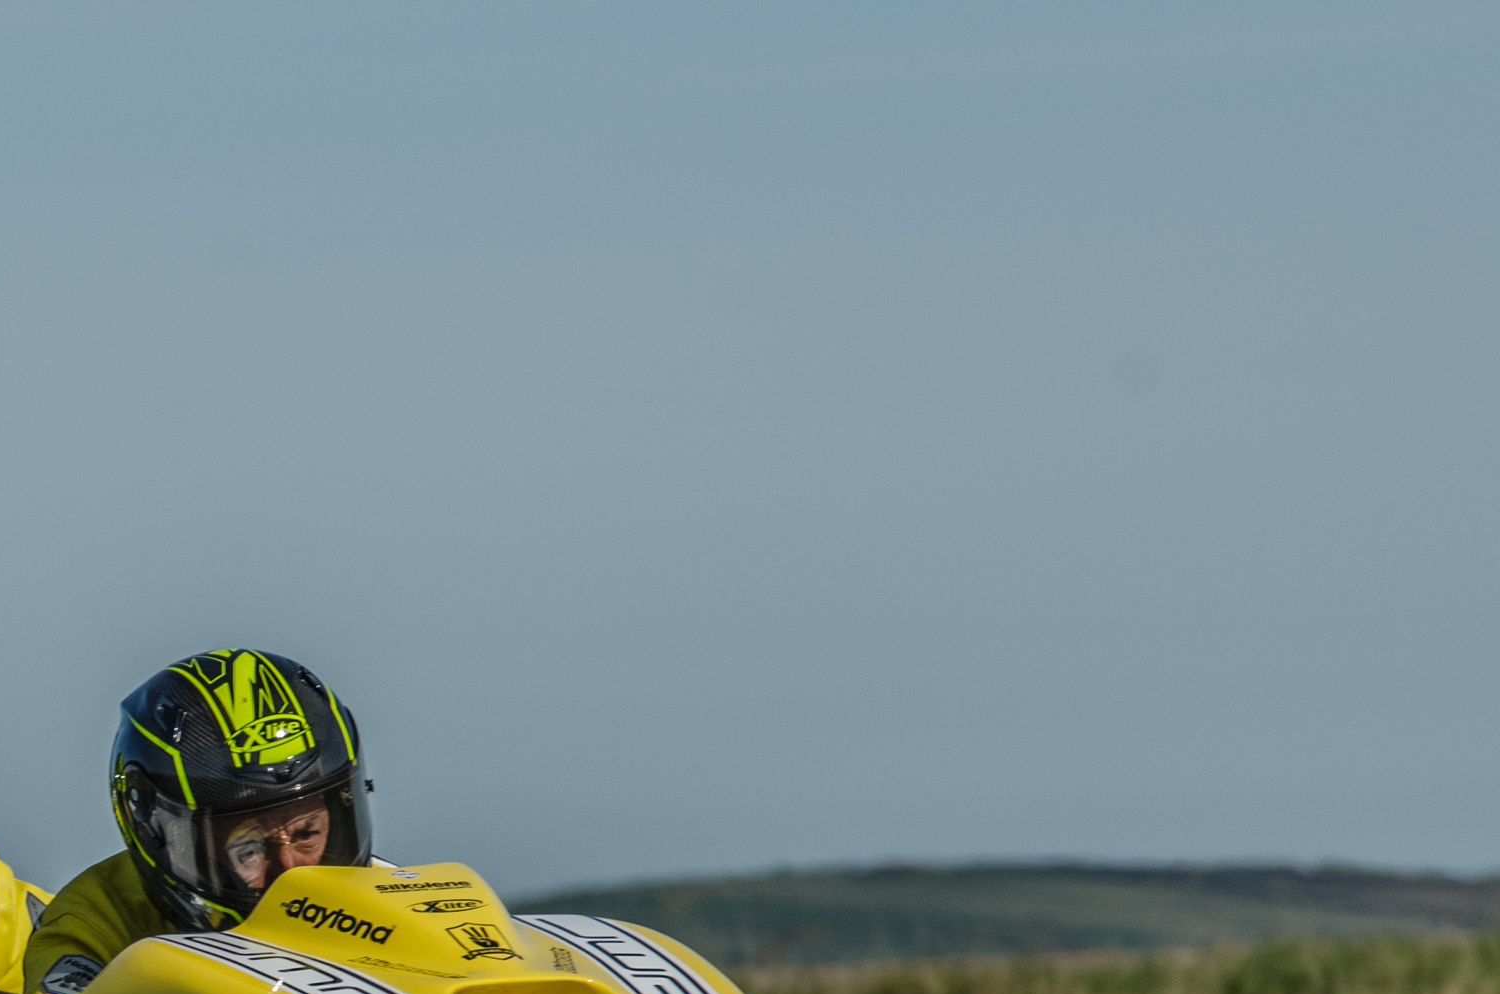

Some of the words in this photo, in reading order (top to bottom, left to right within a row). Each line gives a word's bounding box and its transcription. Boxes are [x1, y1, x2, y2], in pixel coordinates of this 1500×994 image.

[245, 721, 300, 750] X-lite
[375, 881, 471, 892] Silkolene
[286, 897, 394, 945] daytona
